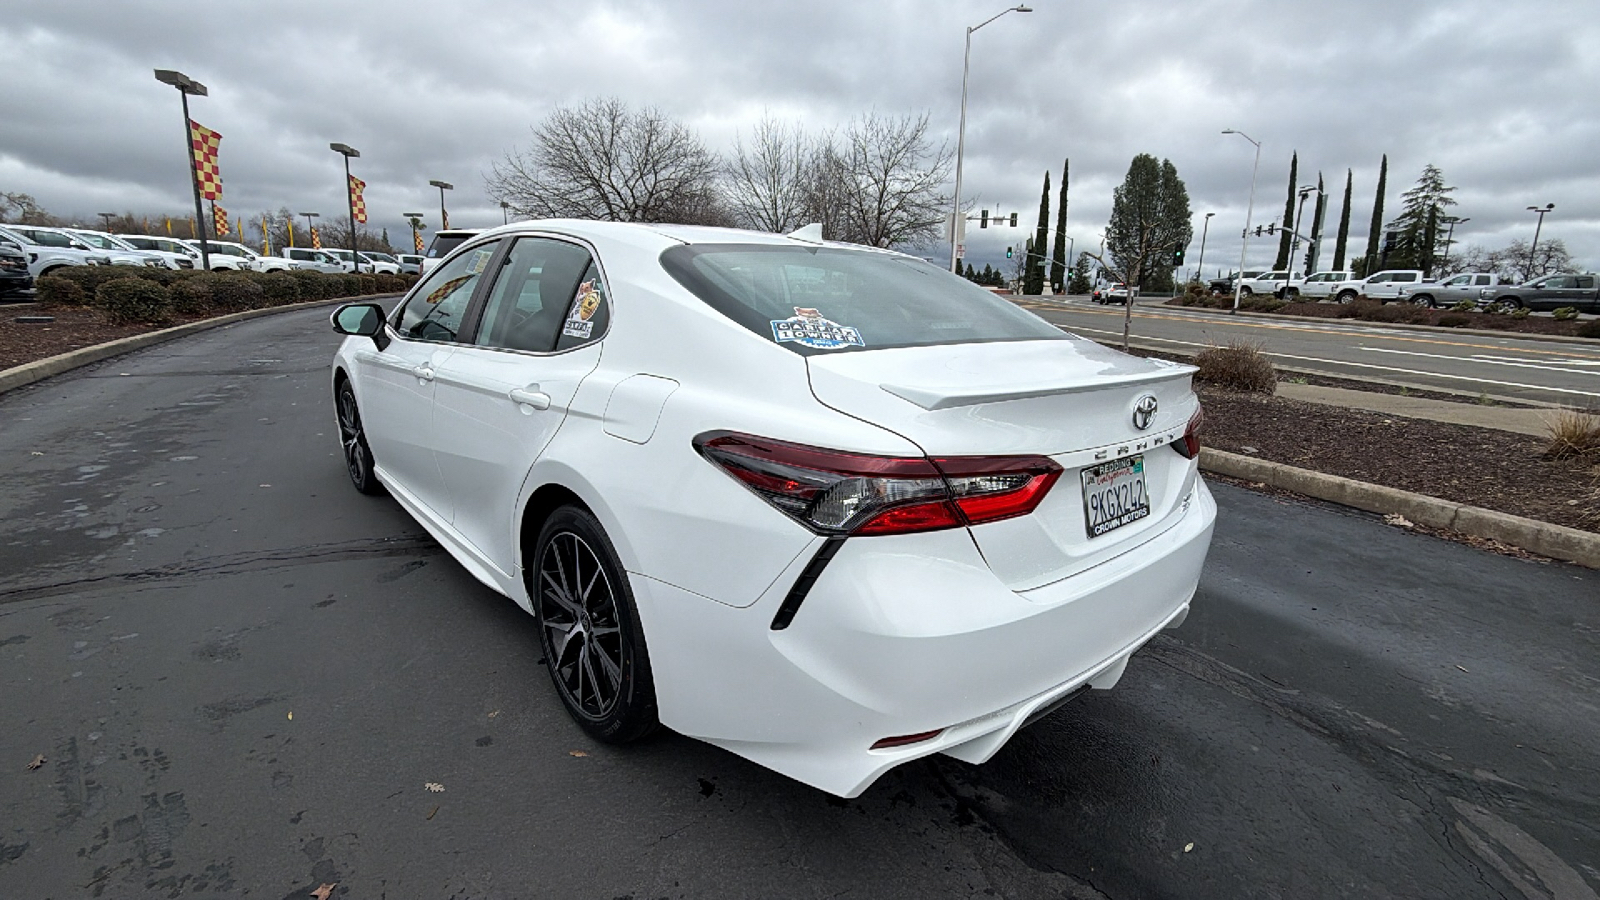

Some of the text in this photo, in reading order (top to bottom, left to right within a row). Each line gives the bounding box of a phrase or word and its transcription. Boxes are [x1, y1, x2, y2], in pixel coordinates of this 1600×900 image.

[1094, 432, 1176, 460] CAMRY
[1096, 467, 1133, 486] California
[1099, 458, 1131, 475] REDDING
[1090, 479, 1145, 526] 9KGX242
[1094, 508, 1148, 536] CROWN MOTORS
